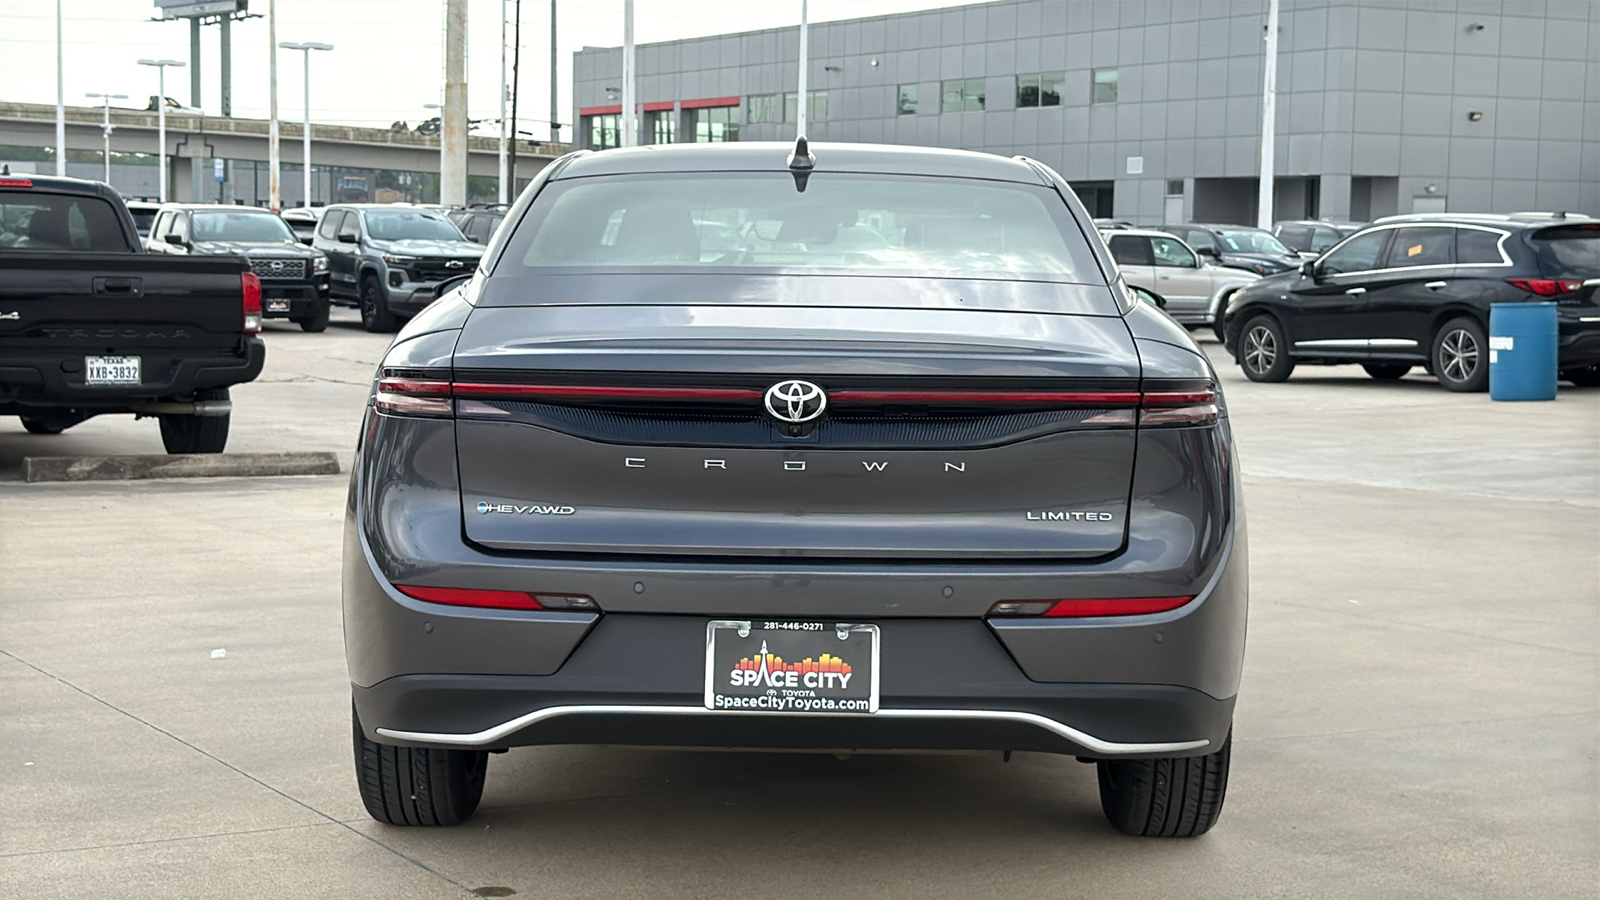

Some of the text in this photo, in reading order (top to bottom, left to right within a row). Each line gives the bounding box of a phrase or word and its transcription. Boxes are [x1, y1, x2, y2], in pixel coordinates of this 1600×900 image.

[625, 457, 966, 472] CROWN
[1026, 511, 1113, 521] LIMITED
[763, 621, 824, 631] 281-446-0271
[730, 669, 852, 689] SPACE CITY
[781, 689, 816, 697] TOYOTA
[715, 694, 869, 711] SpaceCityToyota.com
